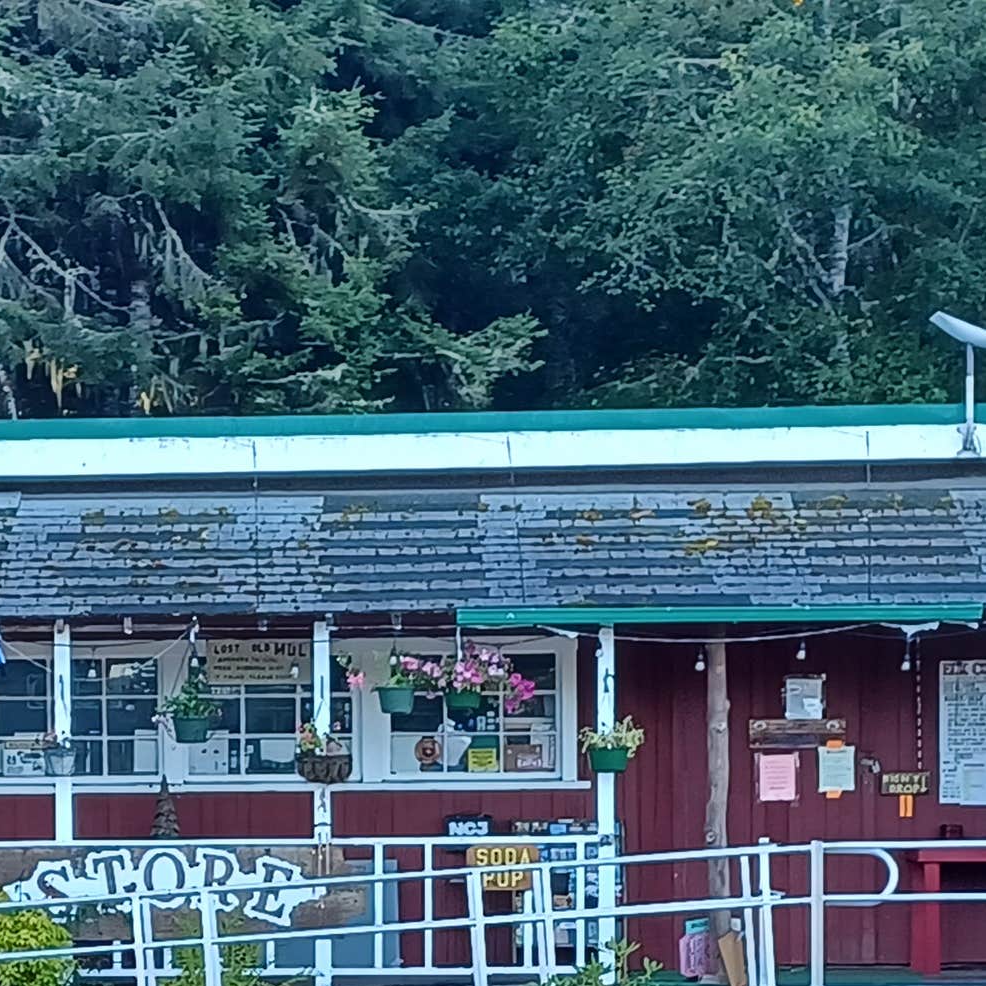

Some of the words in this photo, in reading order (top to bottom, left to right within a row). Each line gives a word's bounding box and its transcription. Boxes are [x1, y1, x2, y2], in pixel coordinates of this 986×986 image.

[214, 644, 239, 655] LOST
[252, 643, 270, 653] OLD
[476, 847, 532, 867] SODA
[36, 851, 294, 919] STORE
